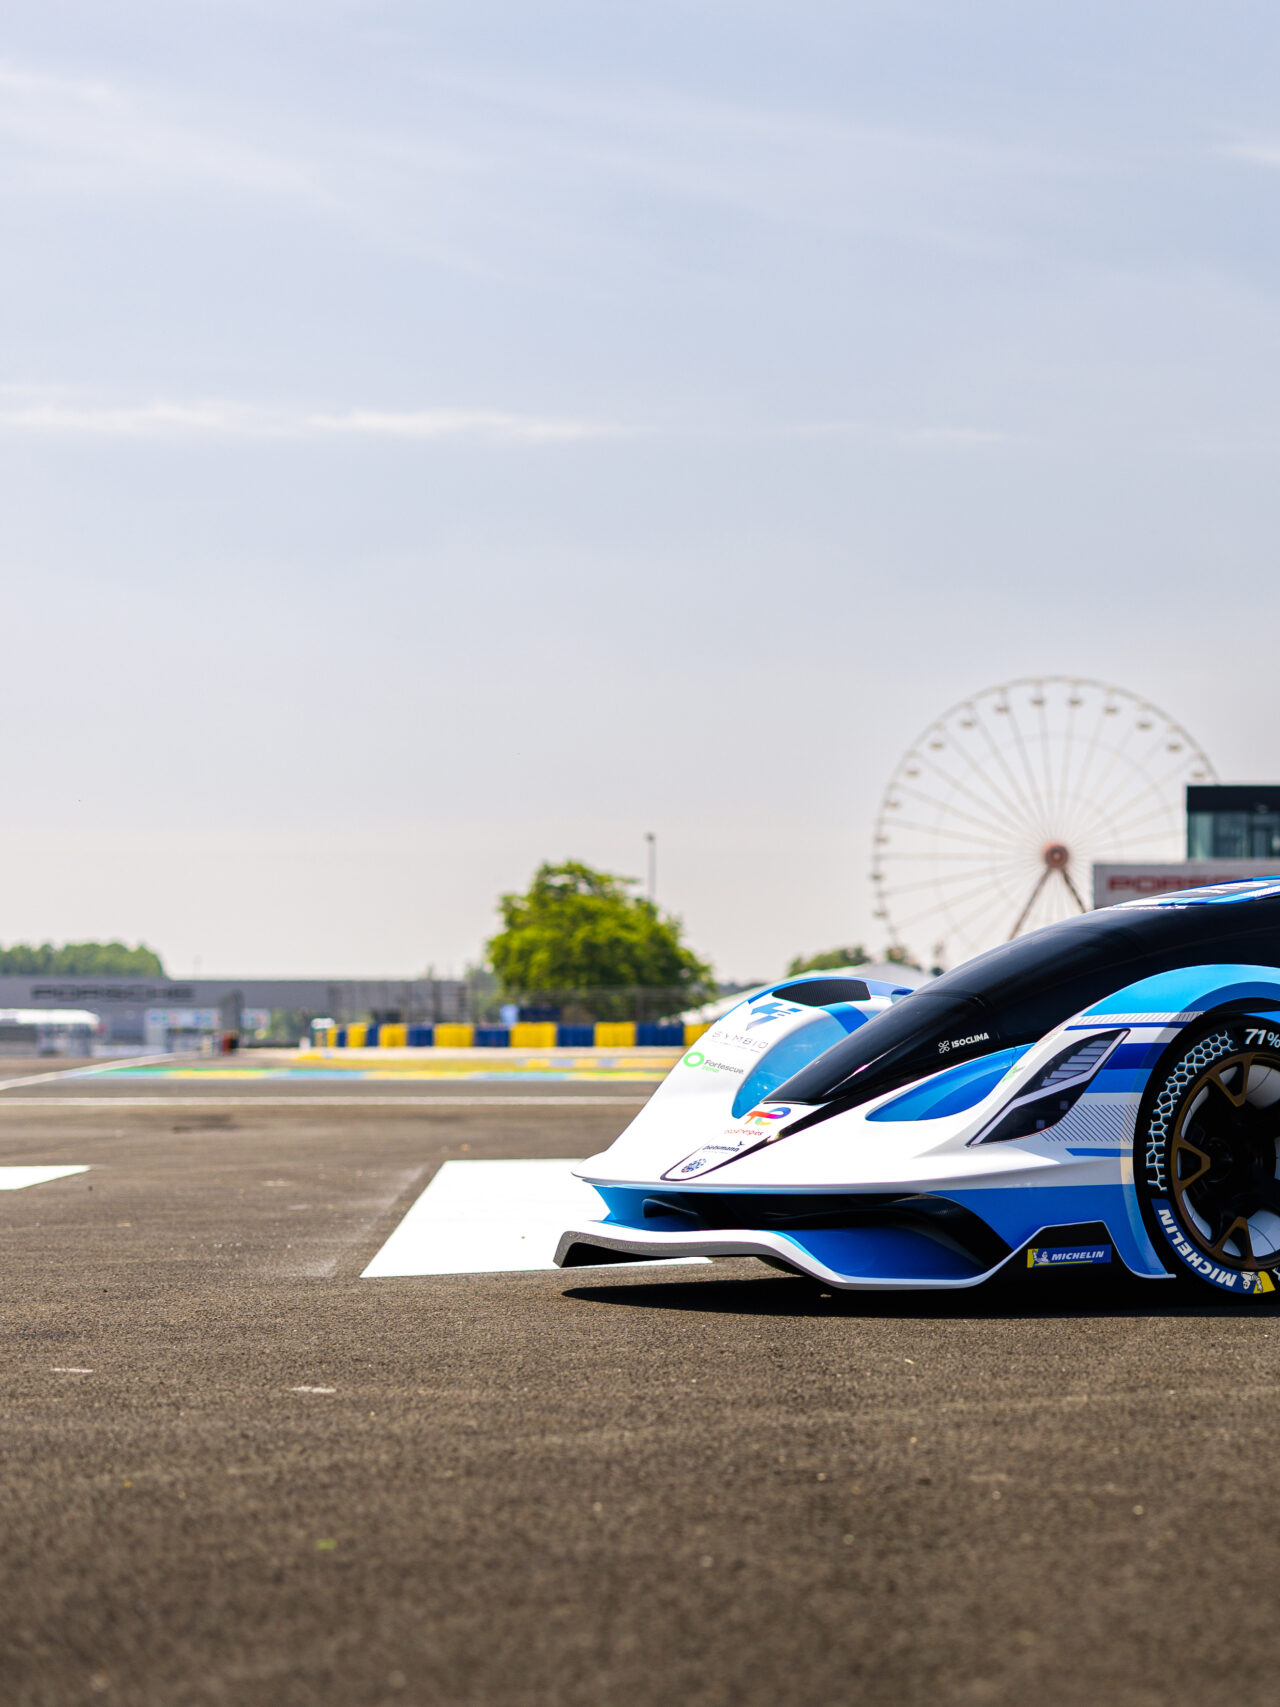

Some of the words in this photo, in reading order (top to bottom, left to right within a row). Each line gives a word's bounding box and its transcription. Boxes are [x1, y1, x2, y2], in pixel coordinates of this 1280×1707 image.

[712, 1031, 769, 1049] SYMBIO
[951, 1032, 990, 1048] ISOCLIMA
[1051, 1250, 1104, 1261] MICHELIN
[1157, 1208, 1237, 1288] MICHELIN
